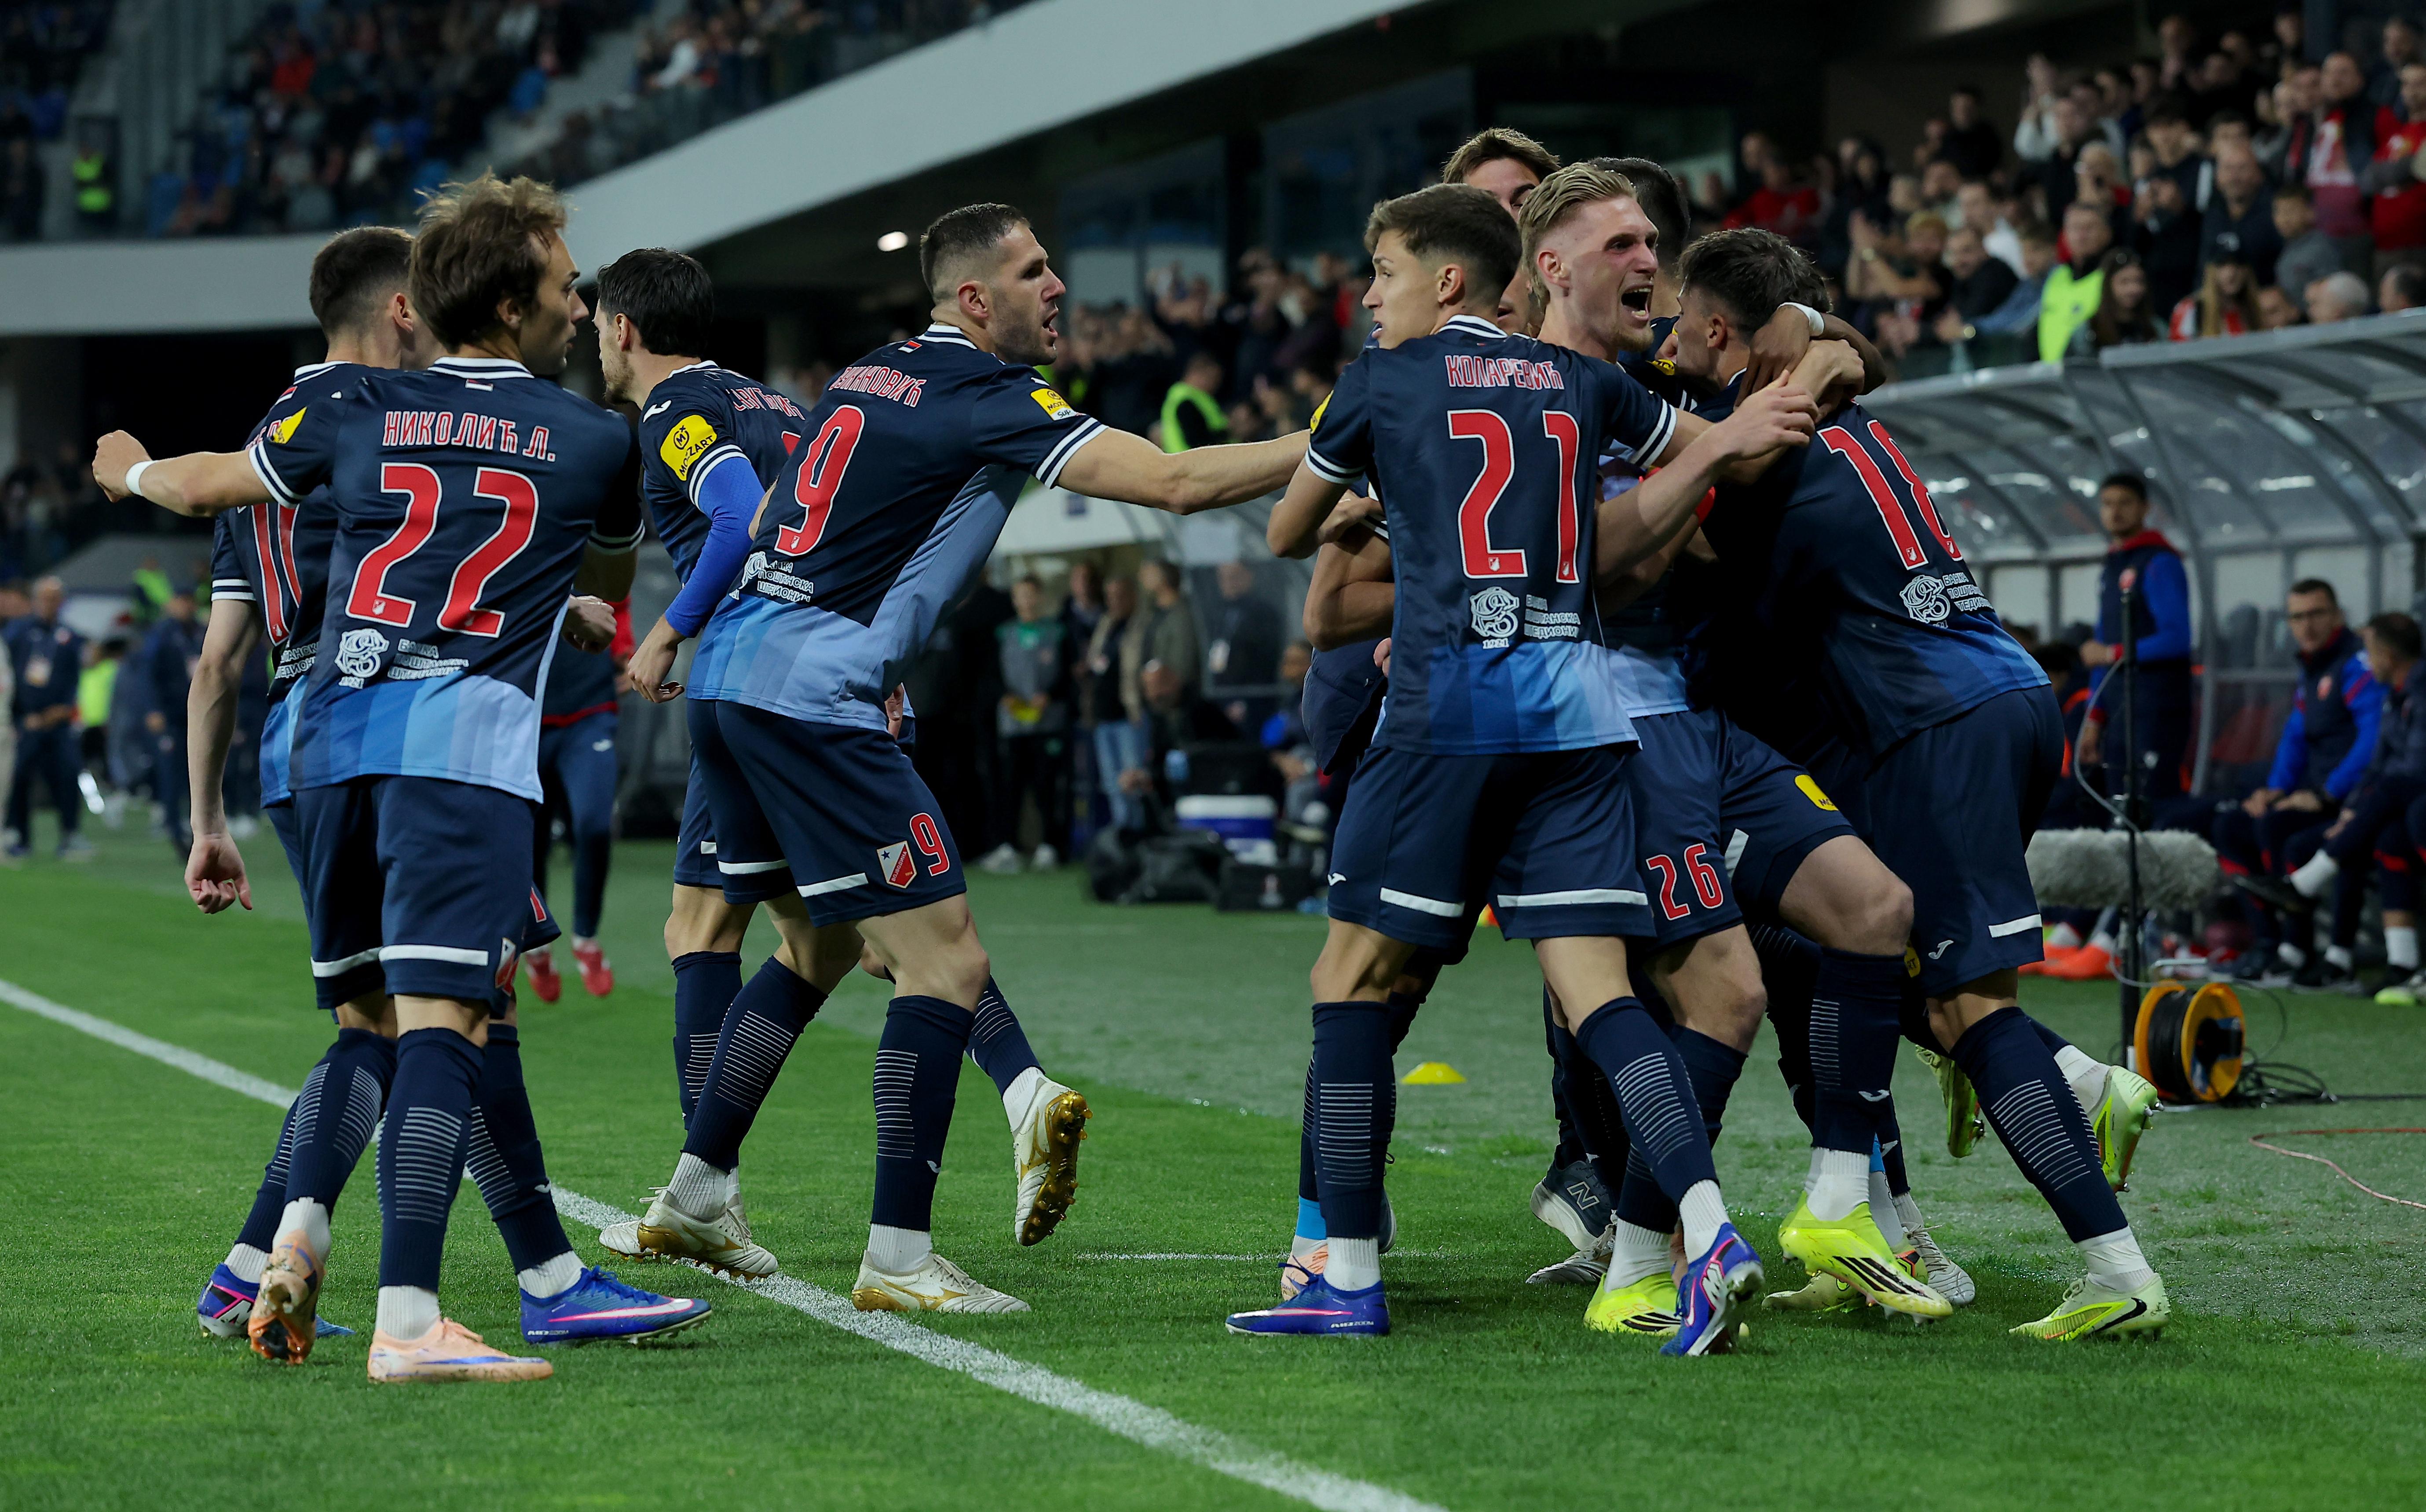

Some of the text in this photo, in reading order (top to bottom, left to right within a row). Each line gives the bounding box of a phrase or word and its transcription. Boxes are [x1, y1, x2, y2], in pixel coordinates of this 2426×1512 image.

[1445, 355, 1565, 391] КОЛАРЕВИЋ
[382, 411, 556, 462] НИКОЛИЋ Л.
[679, 435, 713, 477] MOZART
[774, 404, 866, 556] 9
[1447, 409, 1580, 584] 21
[345, 461, 539, 638] 22
[909, 812, 949, 877] 9
[1646, 843, 1723, 920] 26
